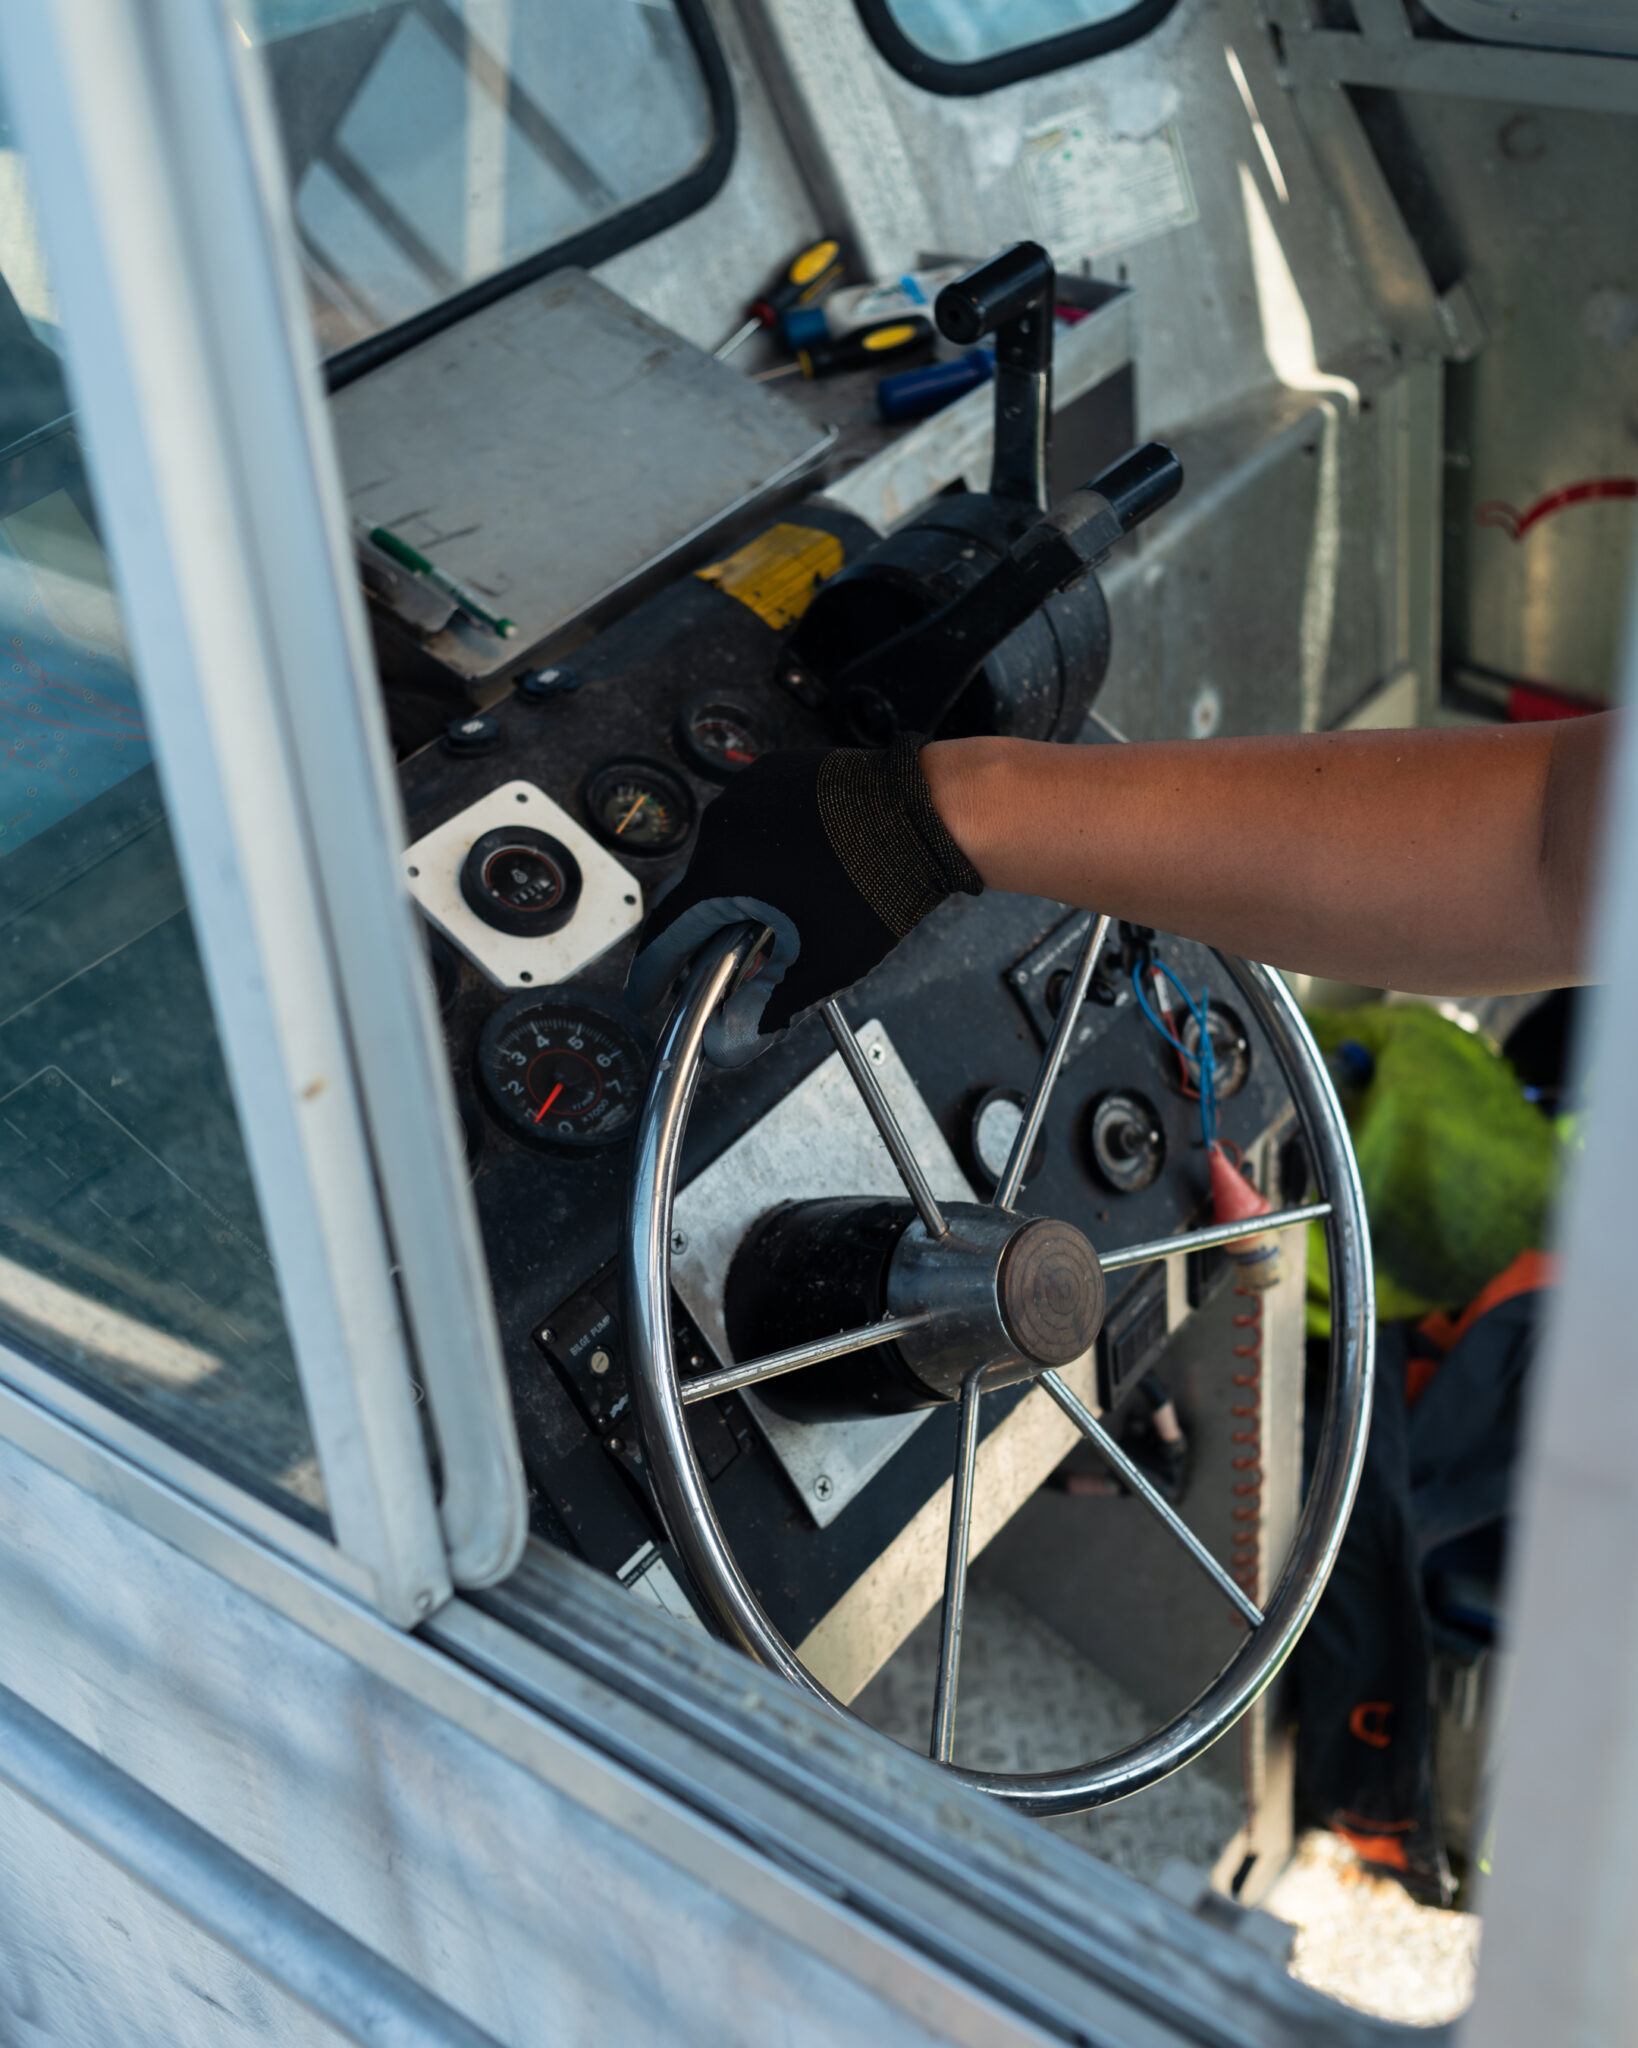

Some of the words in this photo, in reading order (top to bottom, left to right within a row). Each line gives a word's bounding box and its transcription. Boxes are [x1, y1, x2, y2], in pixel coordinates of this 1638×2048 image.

[536, 1035, 549, 1048] 4
[568, 1036, 584, 1050] 5
[511, 1051, 527, 1066] 3
[596, 1053, 612, 1068] 6
[507, 1080, 524, 1096] 2
[606, 1079, 622, 1094] 7
[569, 1333, 592, 1356] BILGE
[590, 1314, 611, 1336] PUMP
